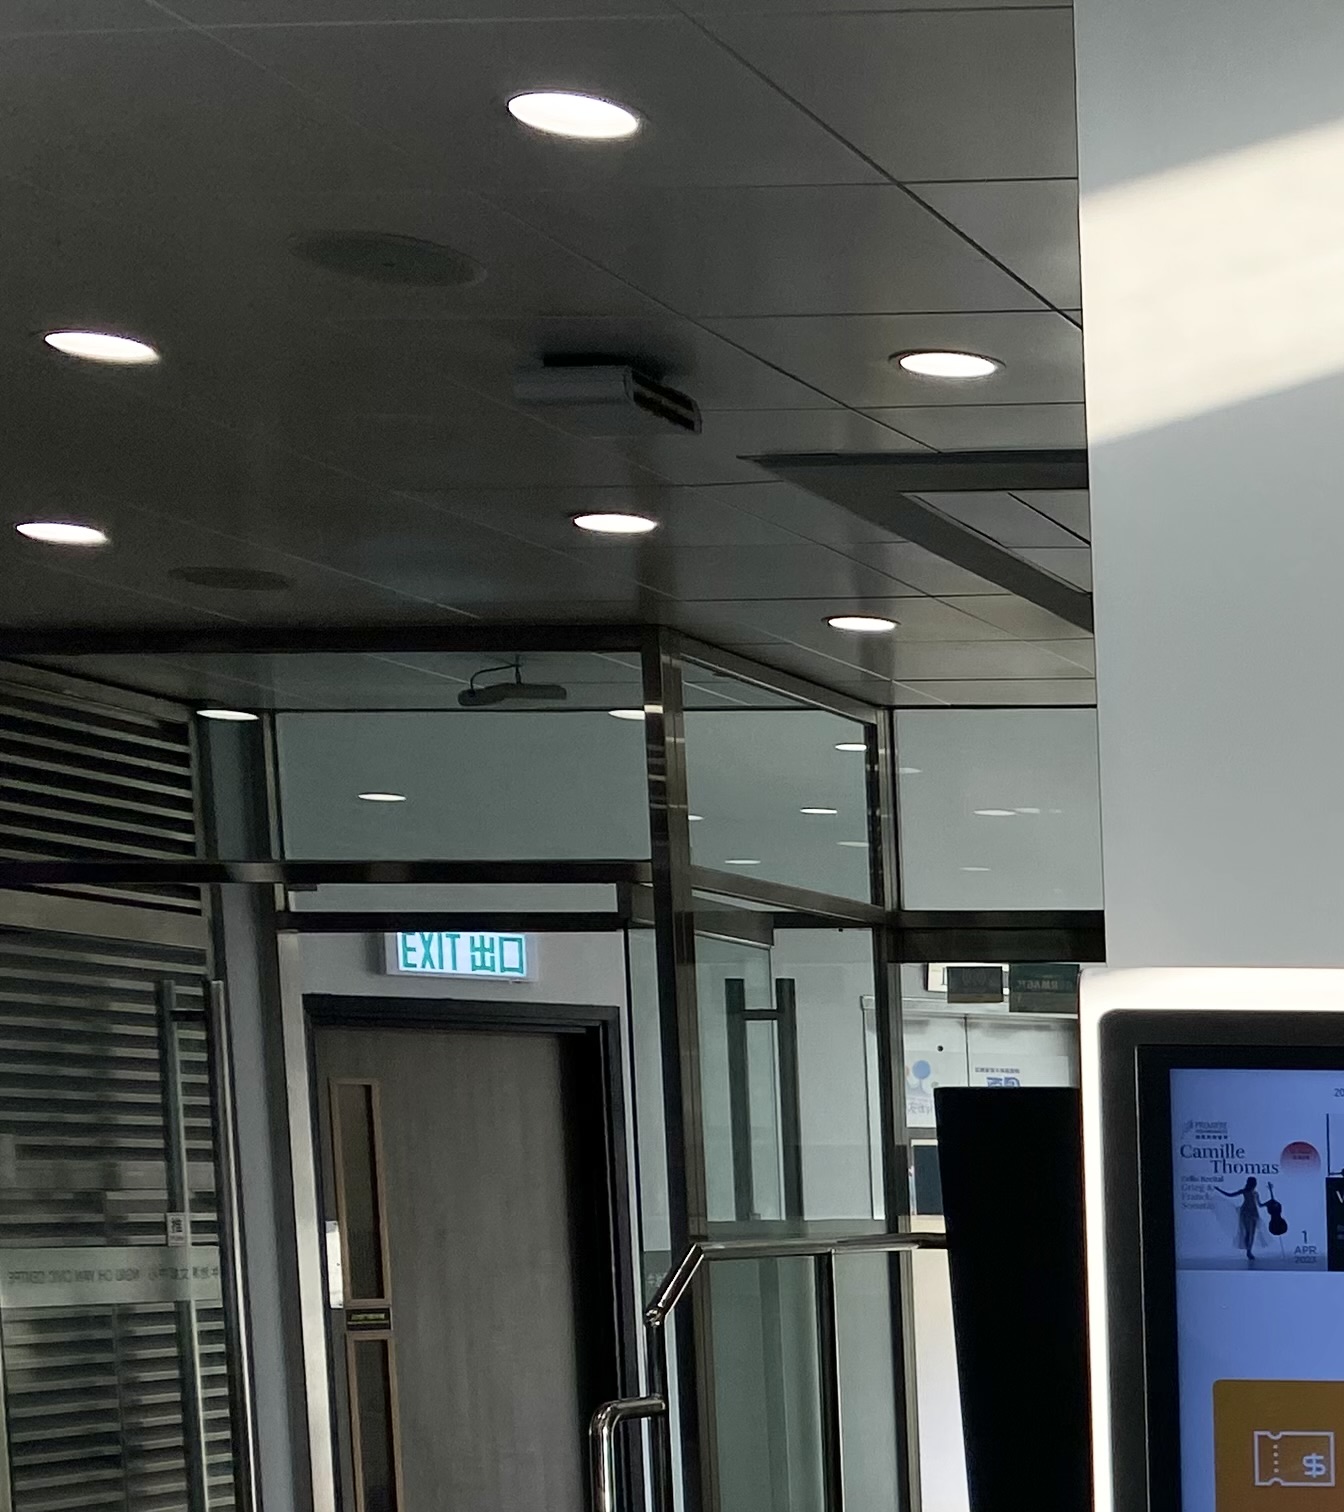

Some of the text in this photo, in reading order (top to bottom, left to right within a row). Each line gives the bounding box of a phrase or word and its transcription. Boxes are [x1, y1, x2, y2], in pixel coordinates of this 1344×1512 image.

[401, 932, 461, 971] EXIT
[469, 935, 524, 975] 出口
[1180, 1143, 1245, 1159] Camille
[1209, 1158, 1280, 1175] Thomas
[1301, 1230, 1308, 1244] 1
[1294, 1245, 1318, 1255] APR
